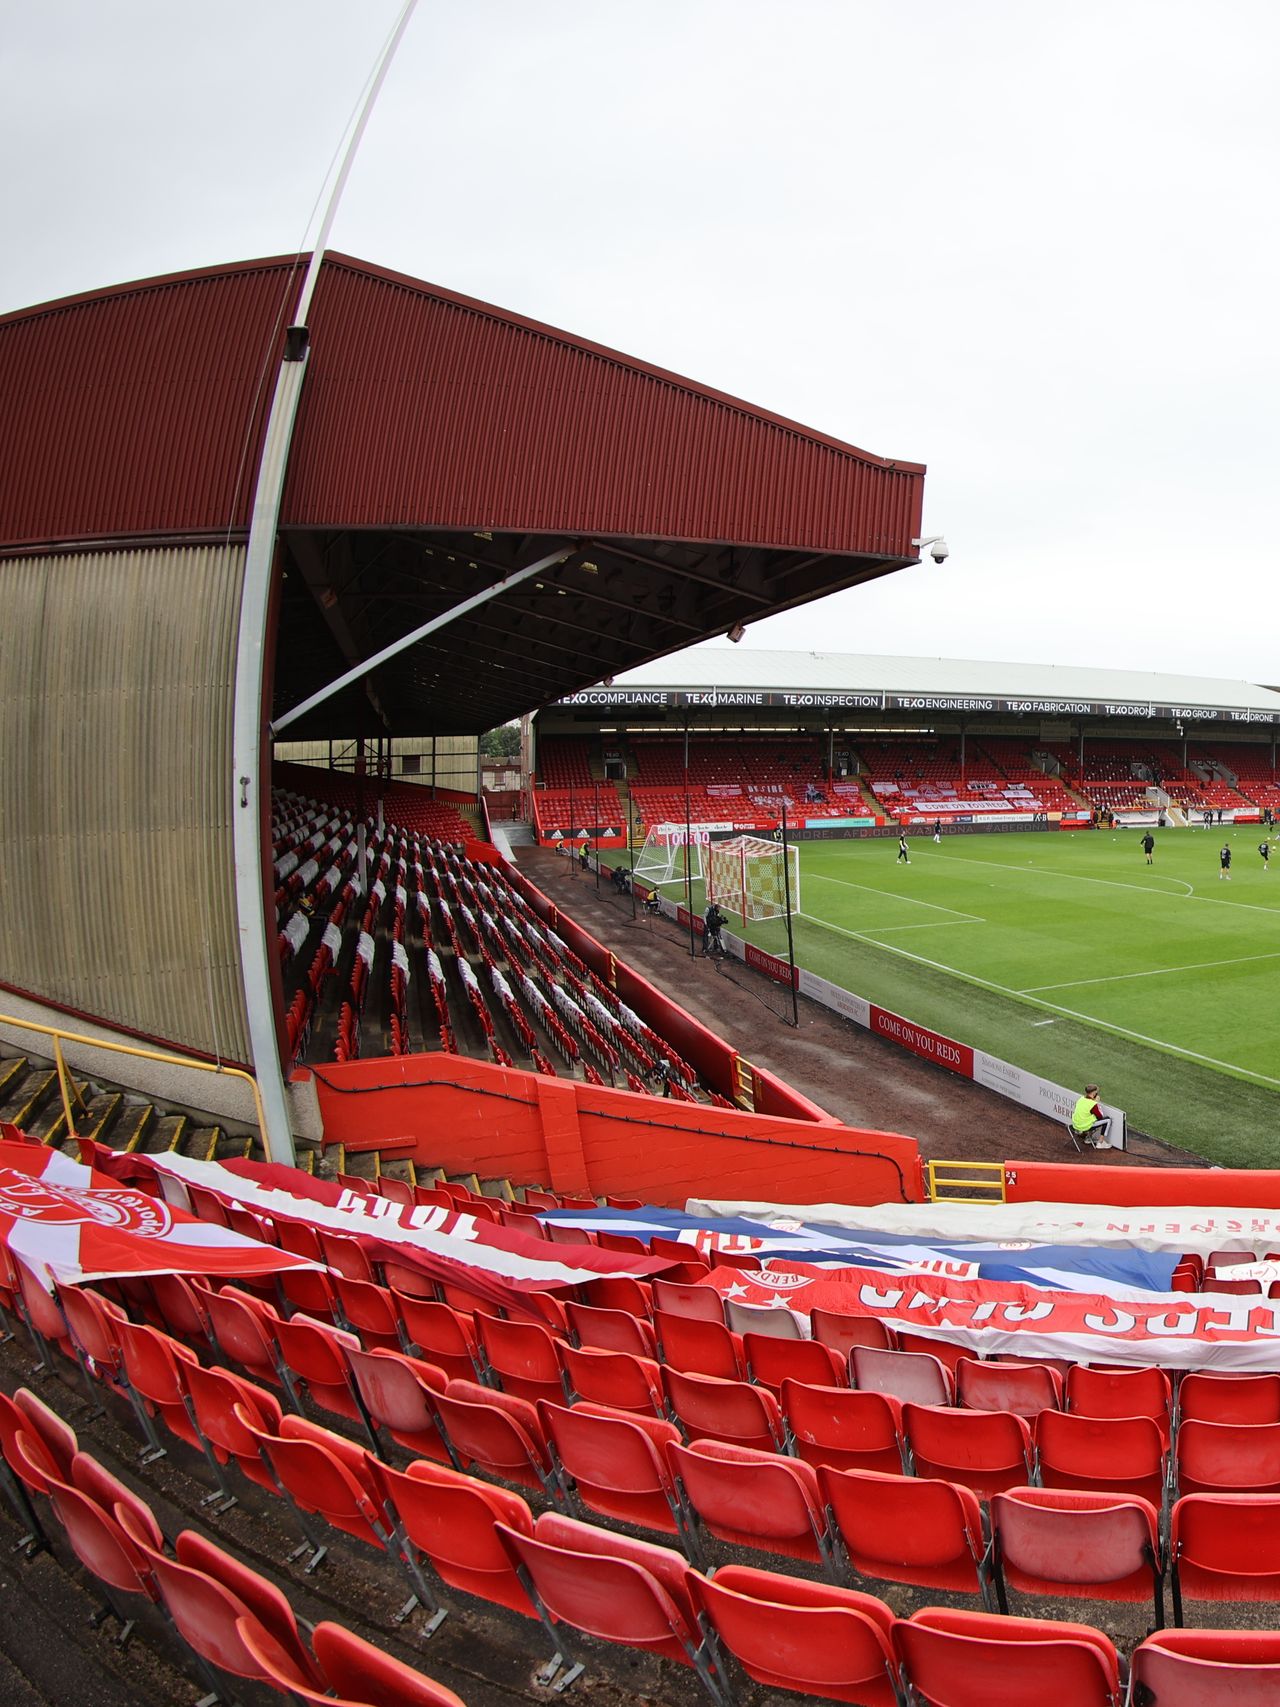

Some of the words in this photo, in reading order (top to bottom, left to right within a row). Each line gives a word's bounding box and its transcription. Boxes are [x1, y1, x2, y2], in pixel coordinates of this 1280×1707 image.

[589, 693, 667, 705] COMPLIANCE
[686, 693, 716, 704] TEXO
[717, 693, 763, 704] MARINE
[784, 694, 814, 705] TEXO
[814, 695, 878, 706] INSPECTION
[898, 697, 926, 708] TEXO
[925, 698, 993, 709] ENGINEERING
[1007, 701, 1032, 711] TEXO
[1033, 702, 1091, 713] FABRICATION
[1105, 705, 1128, 714] TEXO
[1128, 706, 1157, 717] DRONE
[1171, 708, 1192, 718] TEXO
[1192, 709, 1218, 719] GROUP
[1231, 712, 1249, 720] TEXO
[1249, 713, 1274, 722] DRONE
[878, 1014, 901, 1037] COME
[902, 1026, 914, 1043] ON
[914, 1032, 934, 1053] YOU
[936, 1046, 960, 1065] REDS
[1039, 1086, 1060, 1106] PROUD
[1005, 1171, 1016, 1179] 25
